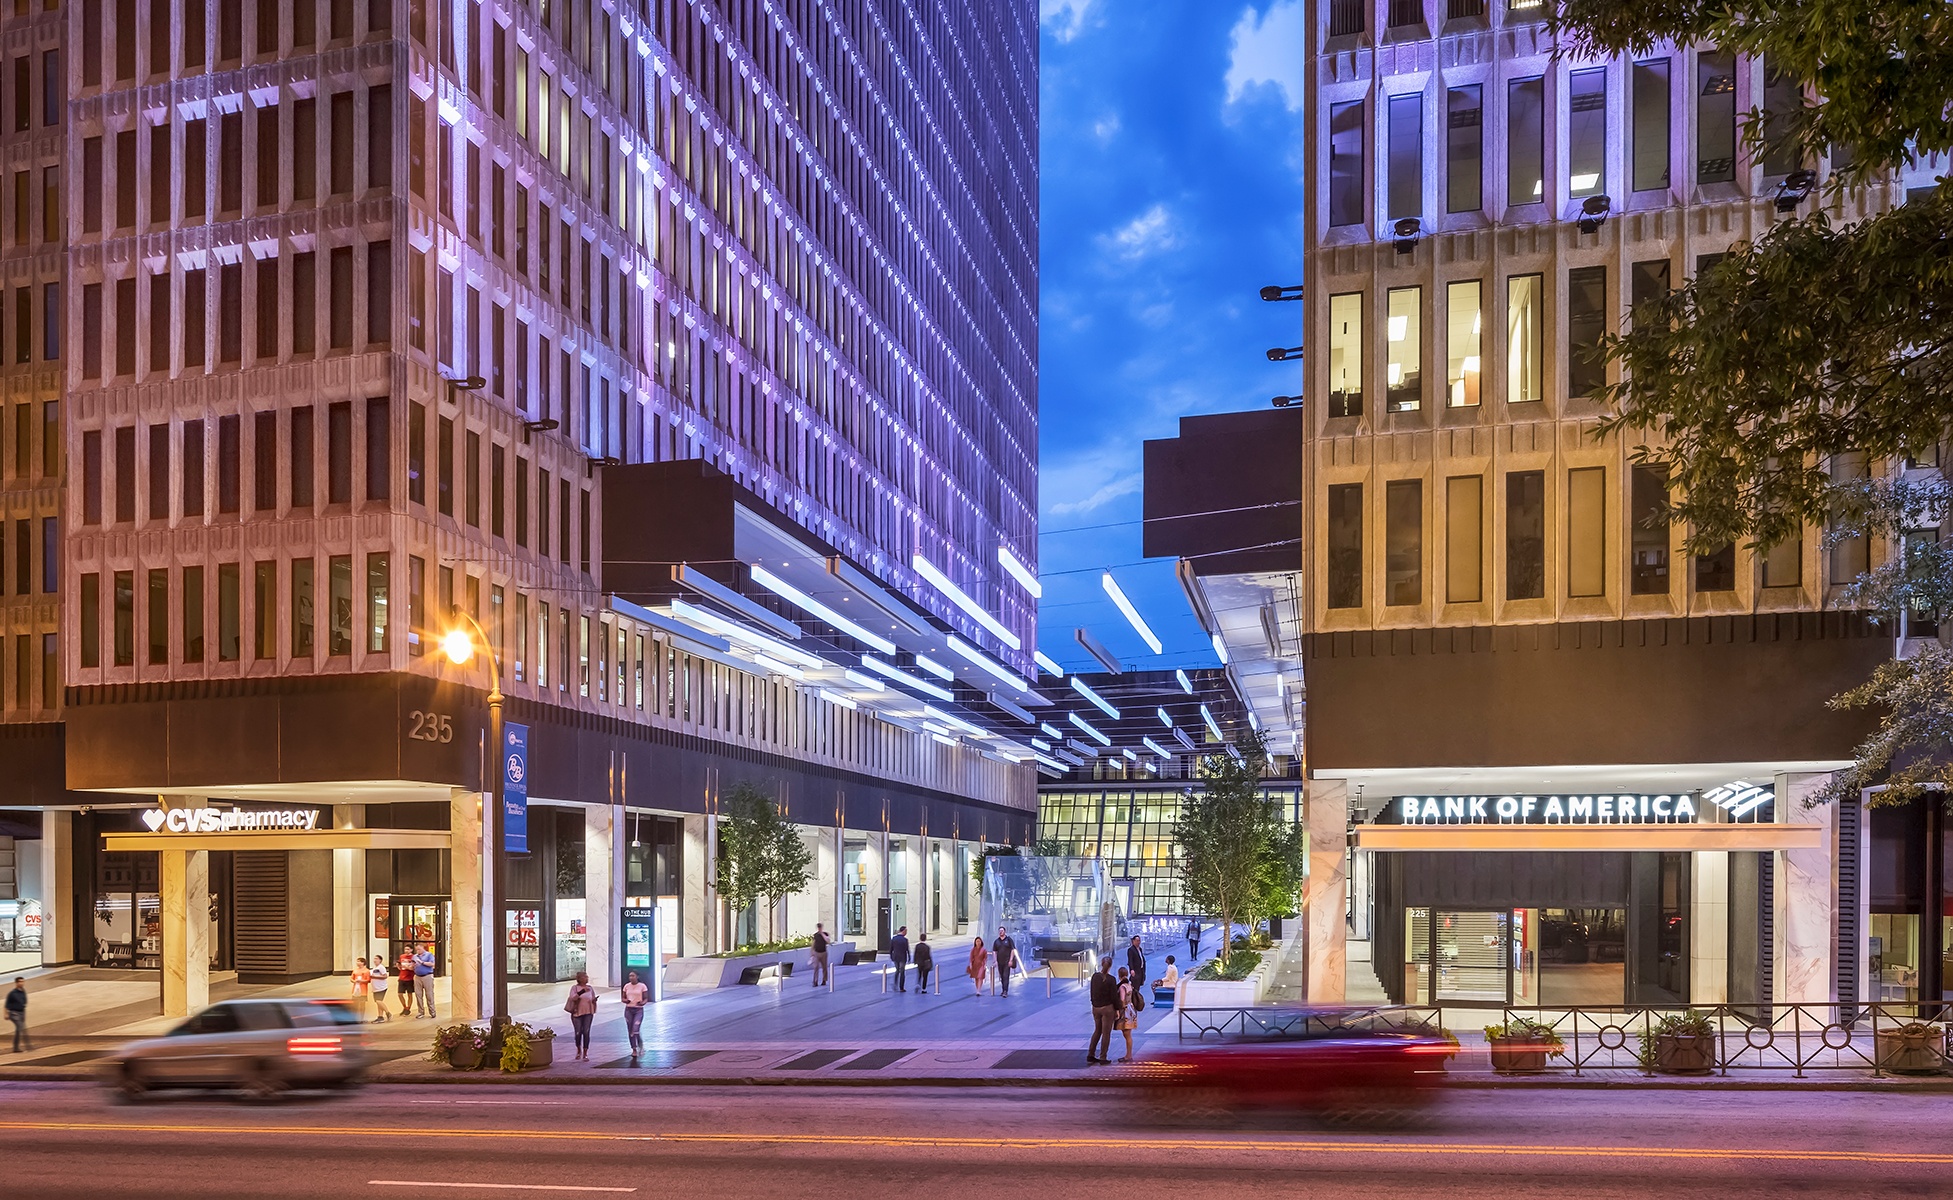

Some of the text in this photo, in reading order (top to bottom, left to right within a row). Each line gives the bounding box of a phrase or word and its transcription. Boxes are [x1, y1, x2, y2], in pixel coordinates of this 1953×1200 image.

[409, 710, 453, 744] 235
[1402, 795, 1696, 818] BANK OF AMERICA
[25, 914, 42, 923] CVS
[509, 929, 537, 943] CVS
